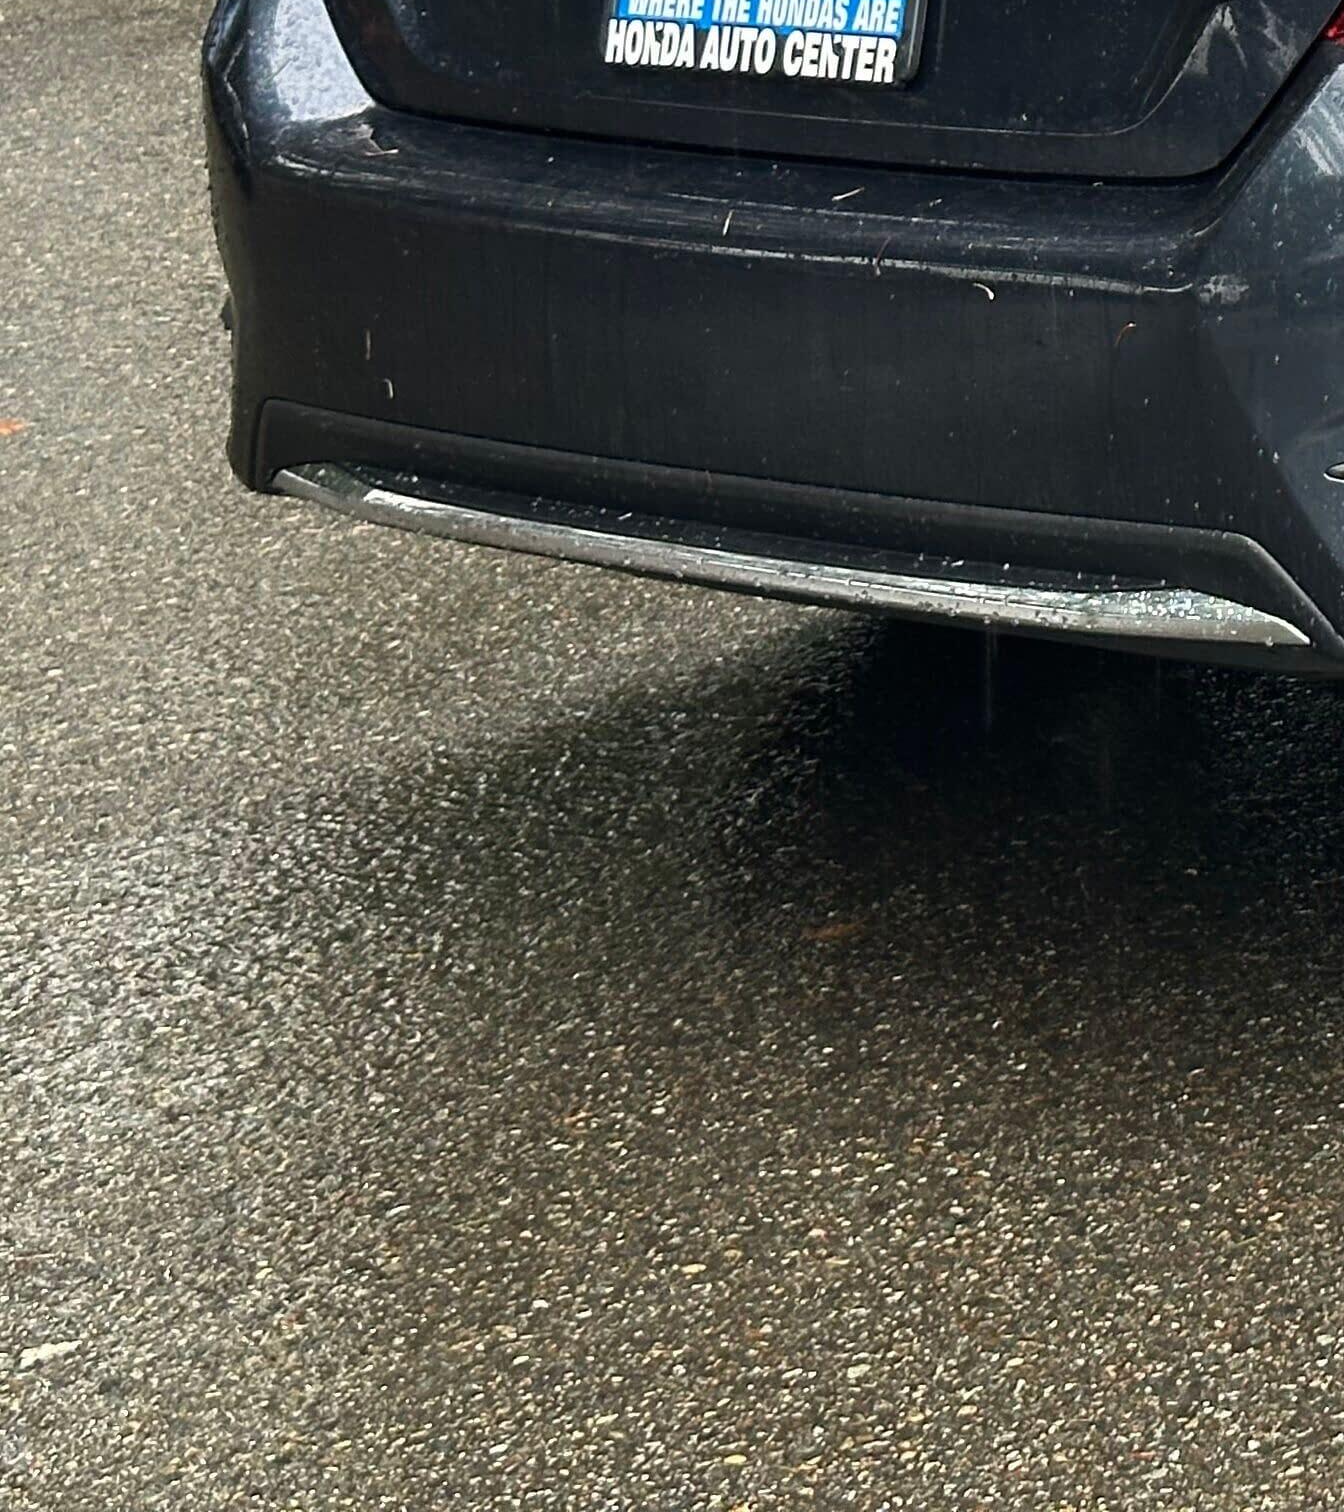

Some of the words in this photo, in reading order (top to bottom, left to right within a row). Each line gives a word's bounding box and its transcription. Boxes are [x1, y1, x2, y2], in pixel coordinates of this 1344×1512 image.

[604, 18, 696, 68] HONDA
[700, 26, 776, 74] AUTO
[783, 31, 898, 83] CENTER
